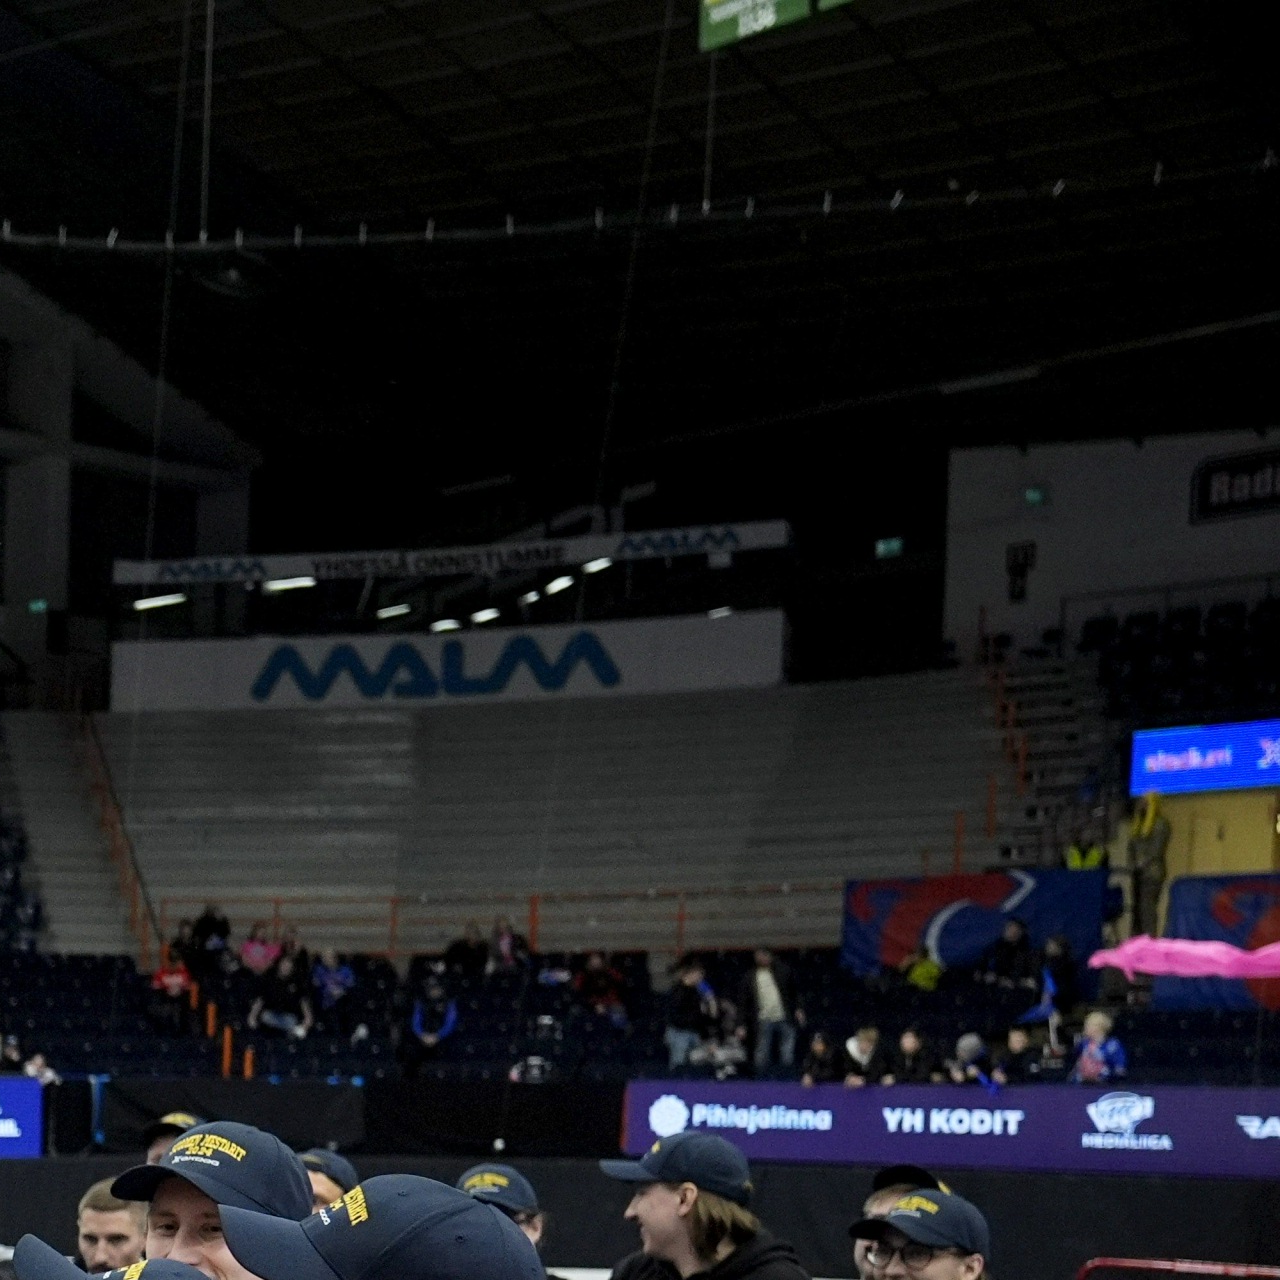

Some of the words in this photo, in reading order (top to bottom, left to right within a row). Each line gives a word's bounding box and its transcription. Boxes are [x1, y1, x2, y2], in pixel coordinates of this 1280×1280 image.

[251, 631, 621, 700] MALM
[690, 1103, 833, 1134] Pihlajalinna
[882, 1107, 925, 1133] YH
[929, 1108, 1025, 1136] KODIT
[201, 1133, 247, 1162] MESTARIT
